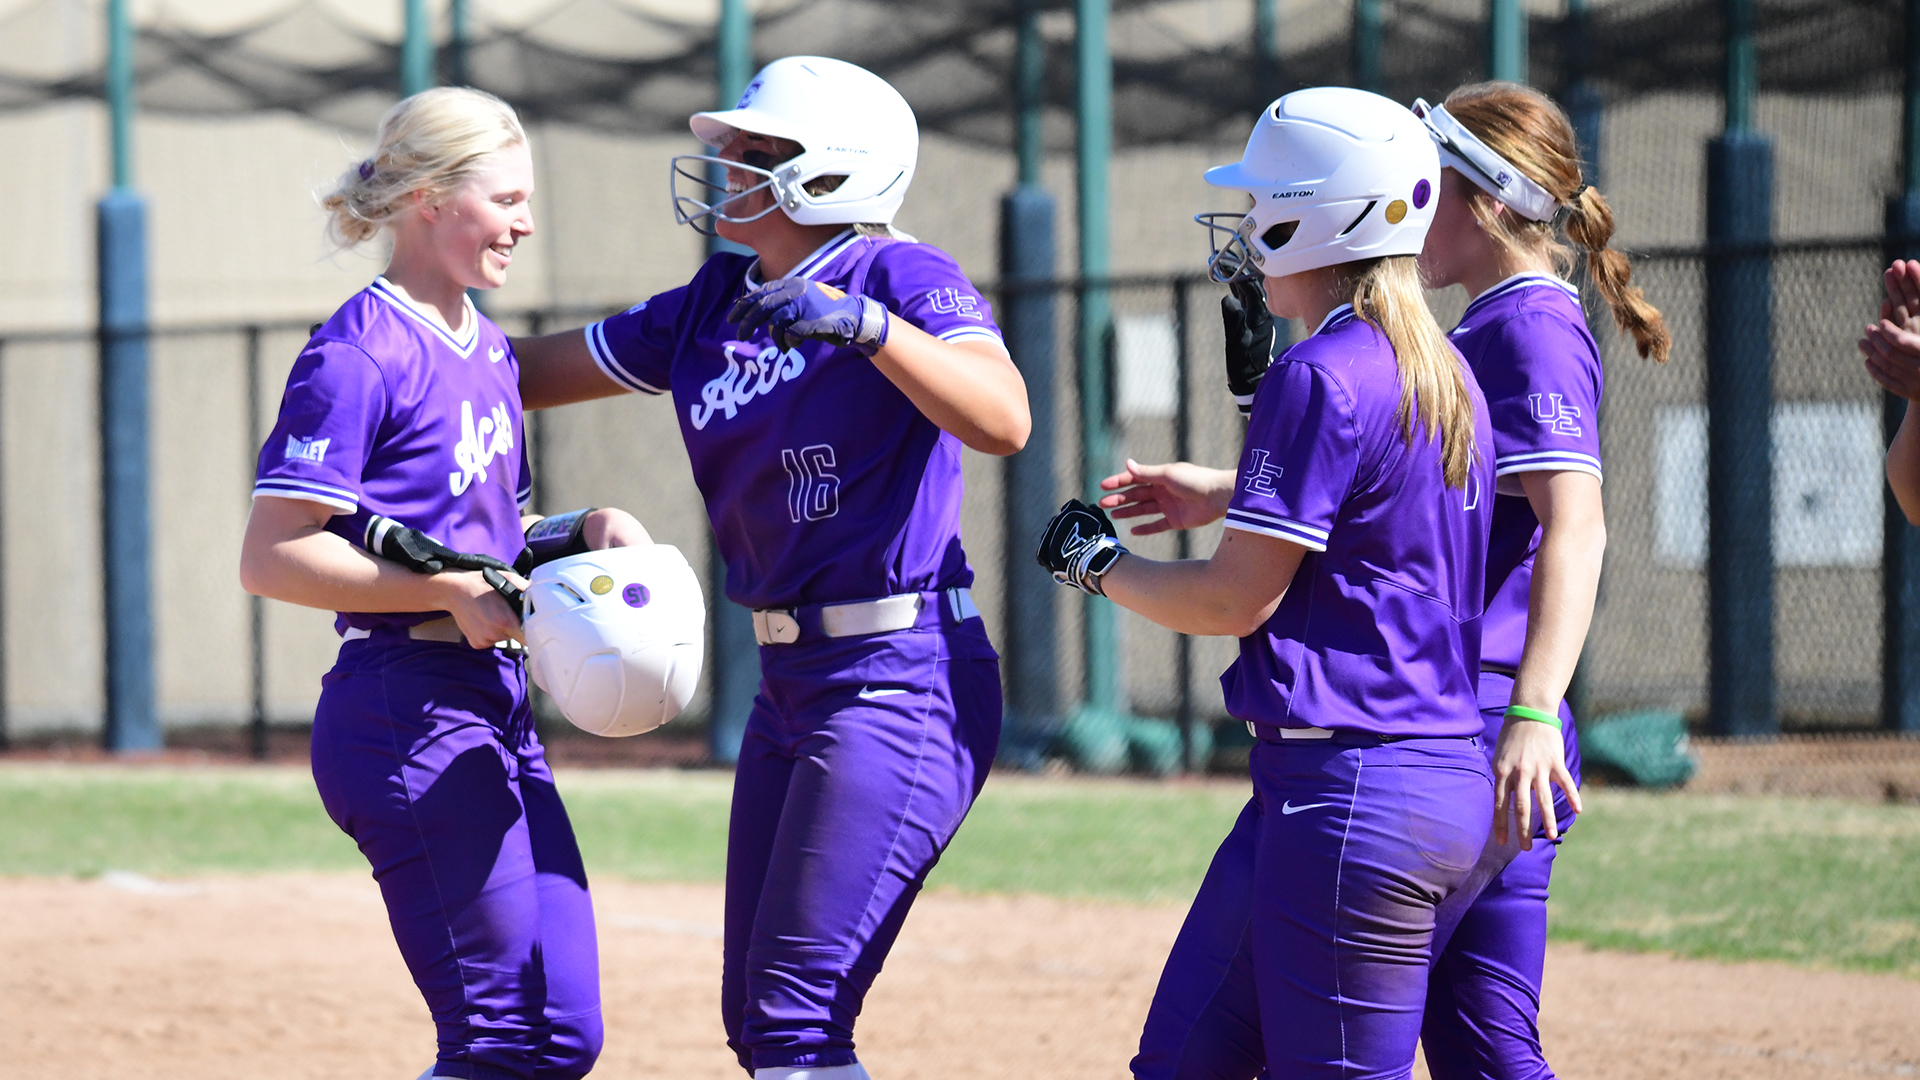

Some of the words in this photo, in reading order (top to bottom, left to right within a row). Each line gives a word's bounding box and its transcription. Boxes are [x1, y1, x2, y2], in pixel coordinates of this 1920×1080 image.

[1272, 190, 1315, 199] EASTON
[1418, 184, 1428, 204] 7
[926, 287, 983, 321] UE
[690, 345, 807, 431] Aces
[1528, 393, 1582, 438] UE
[781, 443, 841, 524] 16
[626, 586, 649, 605] 15
